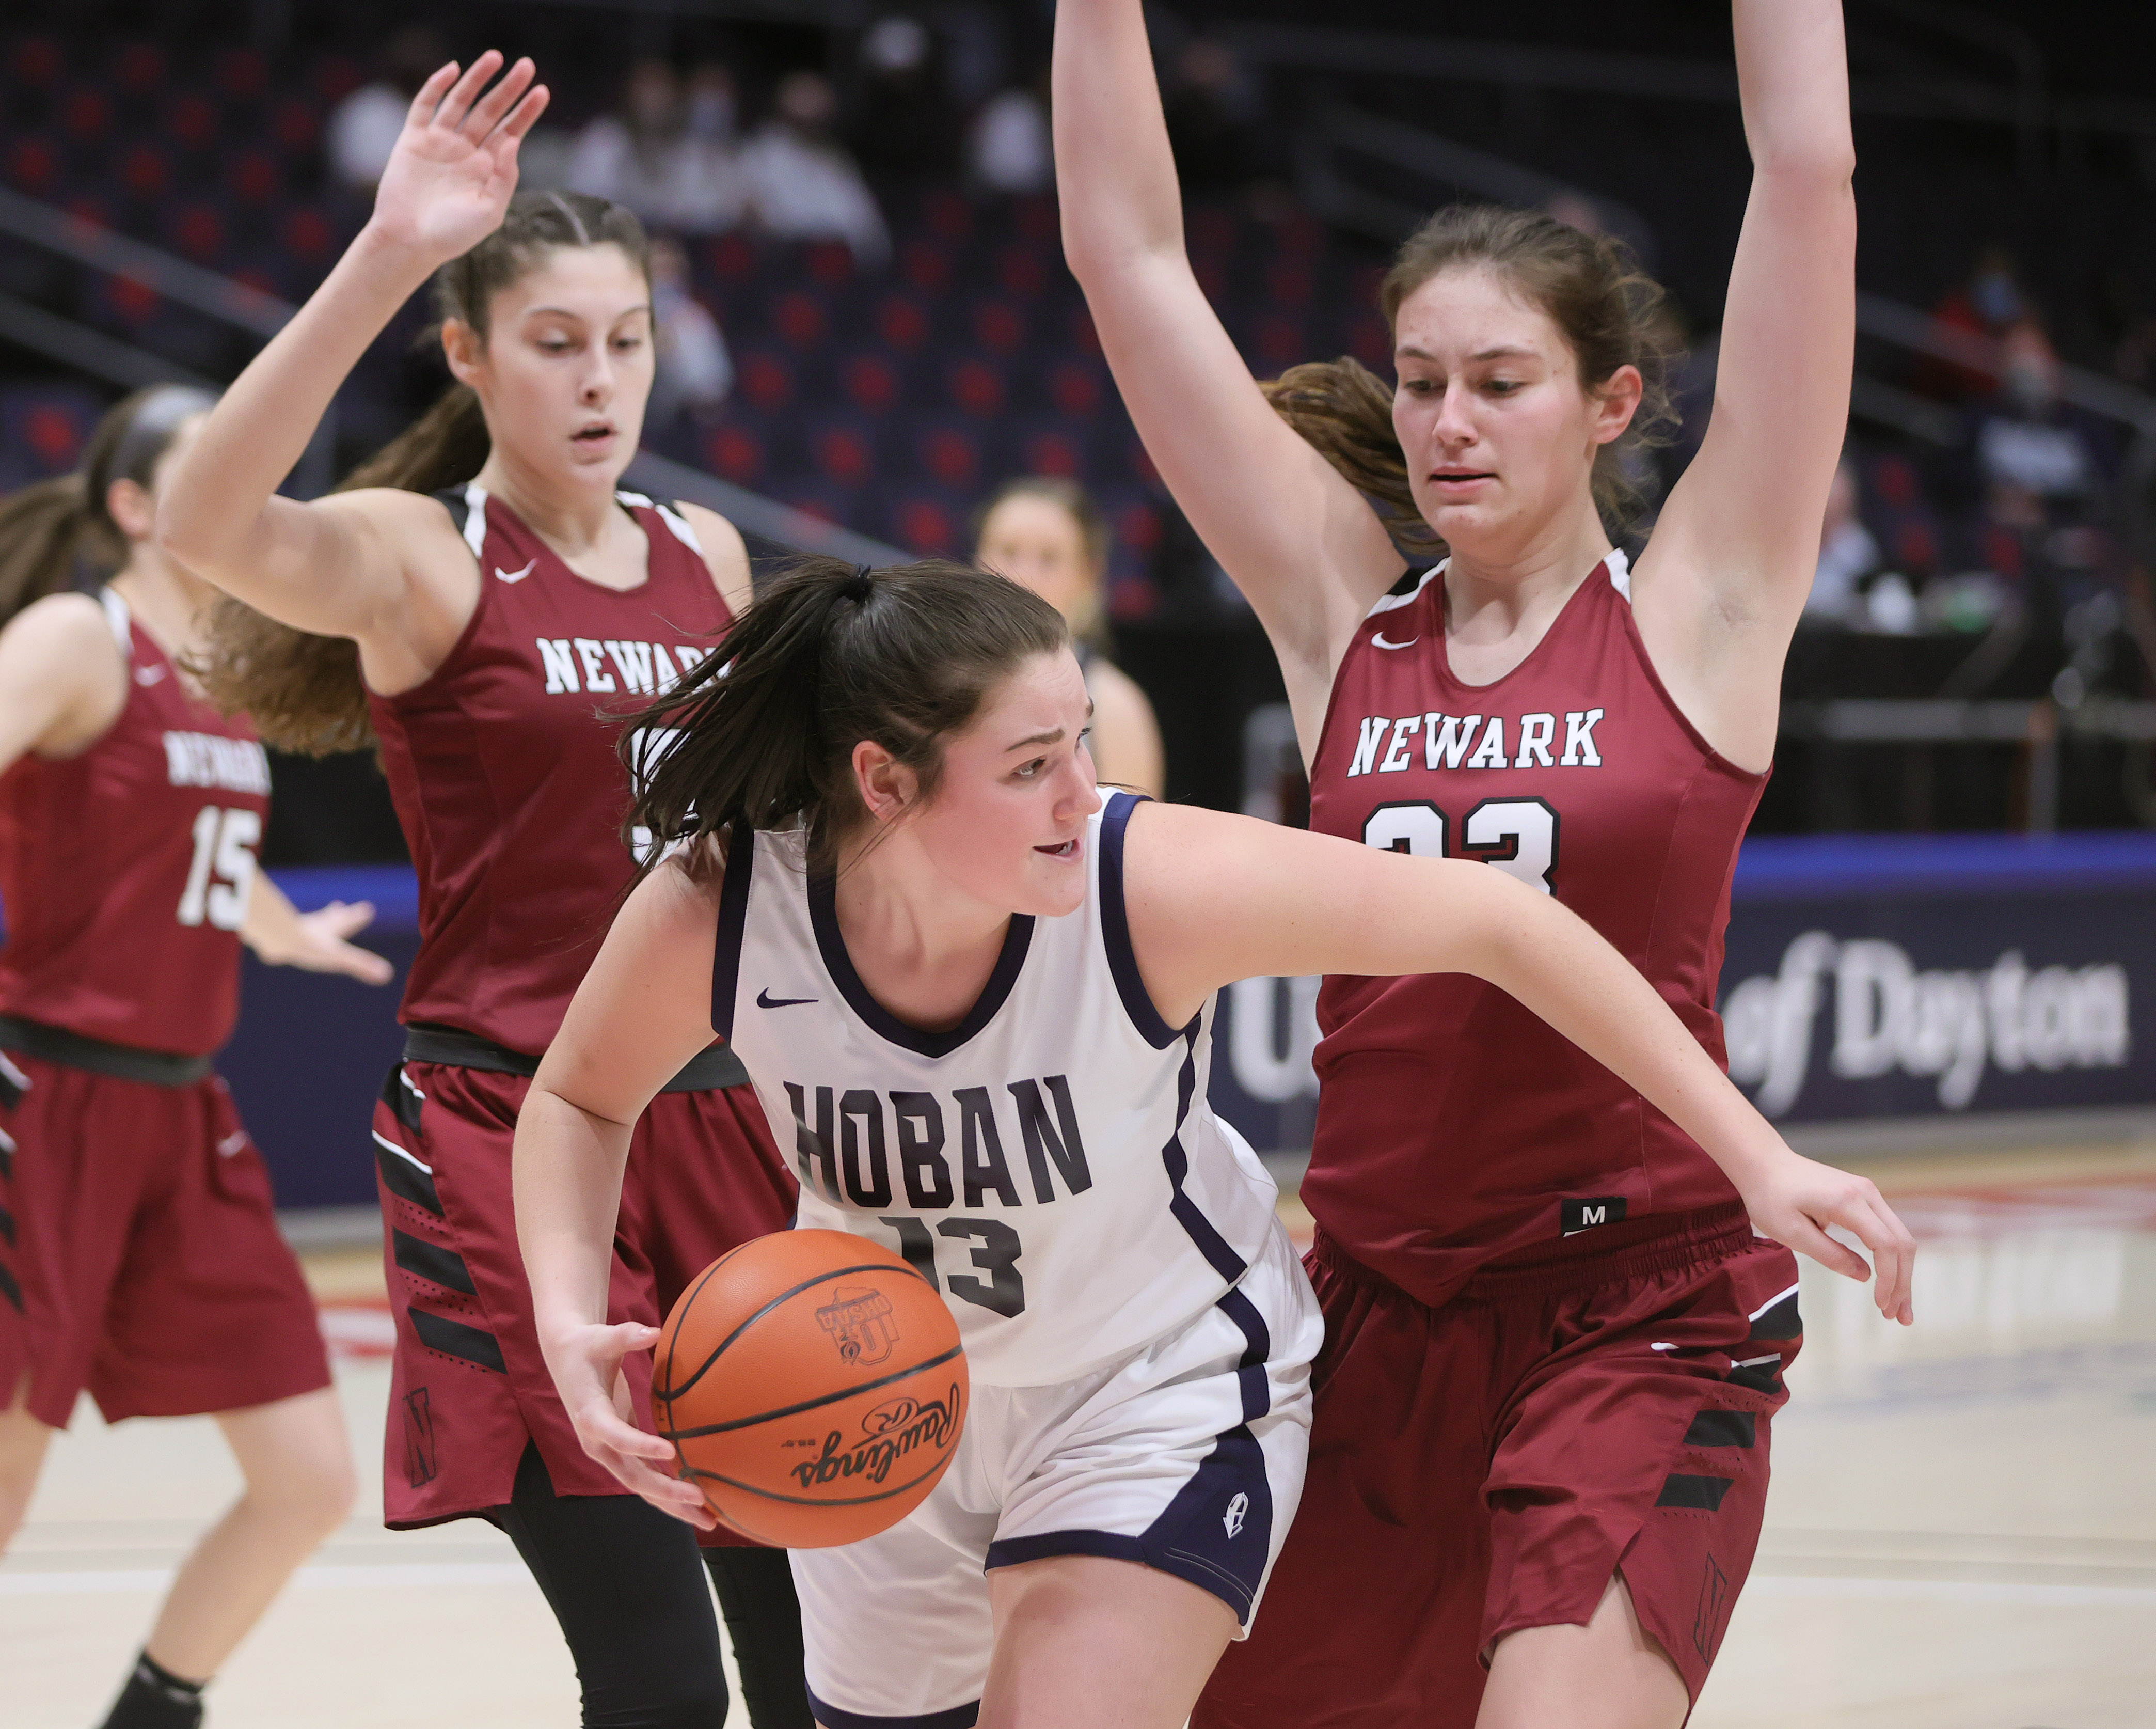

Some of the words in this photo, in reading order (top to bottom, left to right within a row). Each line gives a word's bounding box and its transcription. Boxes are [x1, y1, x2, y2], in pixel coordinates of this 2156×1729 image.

[1346, 707, 1605, 778] NEWARK
[177, 804, 262, 931] 15
[1719, 930, 1838, 1119] of
[1831, 937, 2130, 1110] Dayton
[783, 1074, 1093, 1209] HOBAN
[878, 1216, 1026, 1318] 13
[1582, 1205, 1606, 1225] M
[790, 1380, 960, 1488] Rawlings
